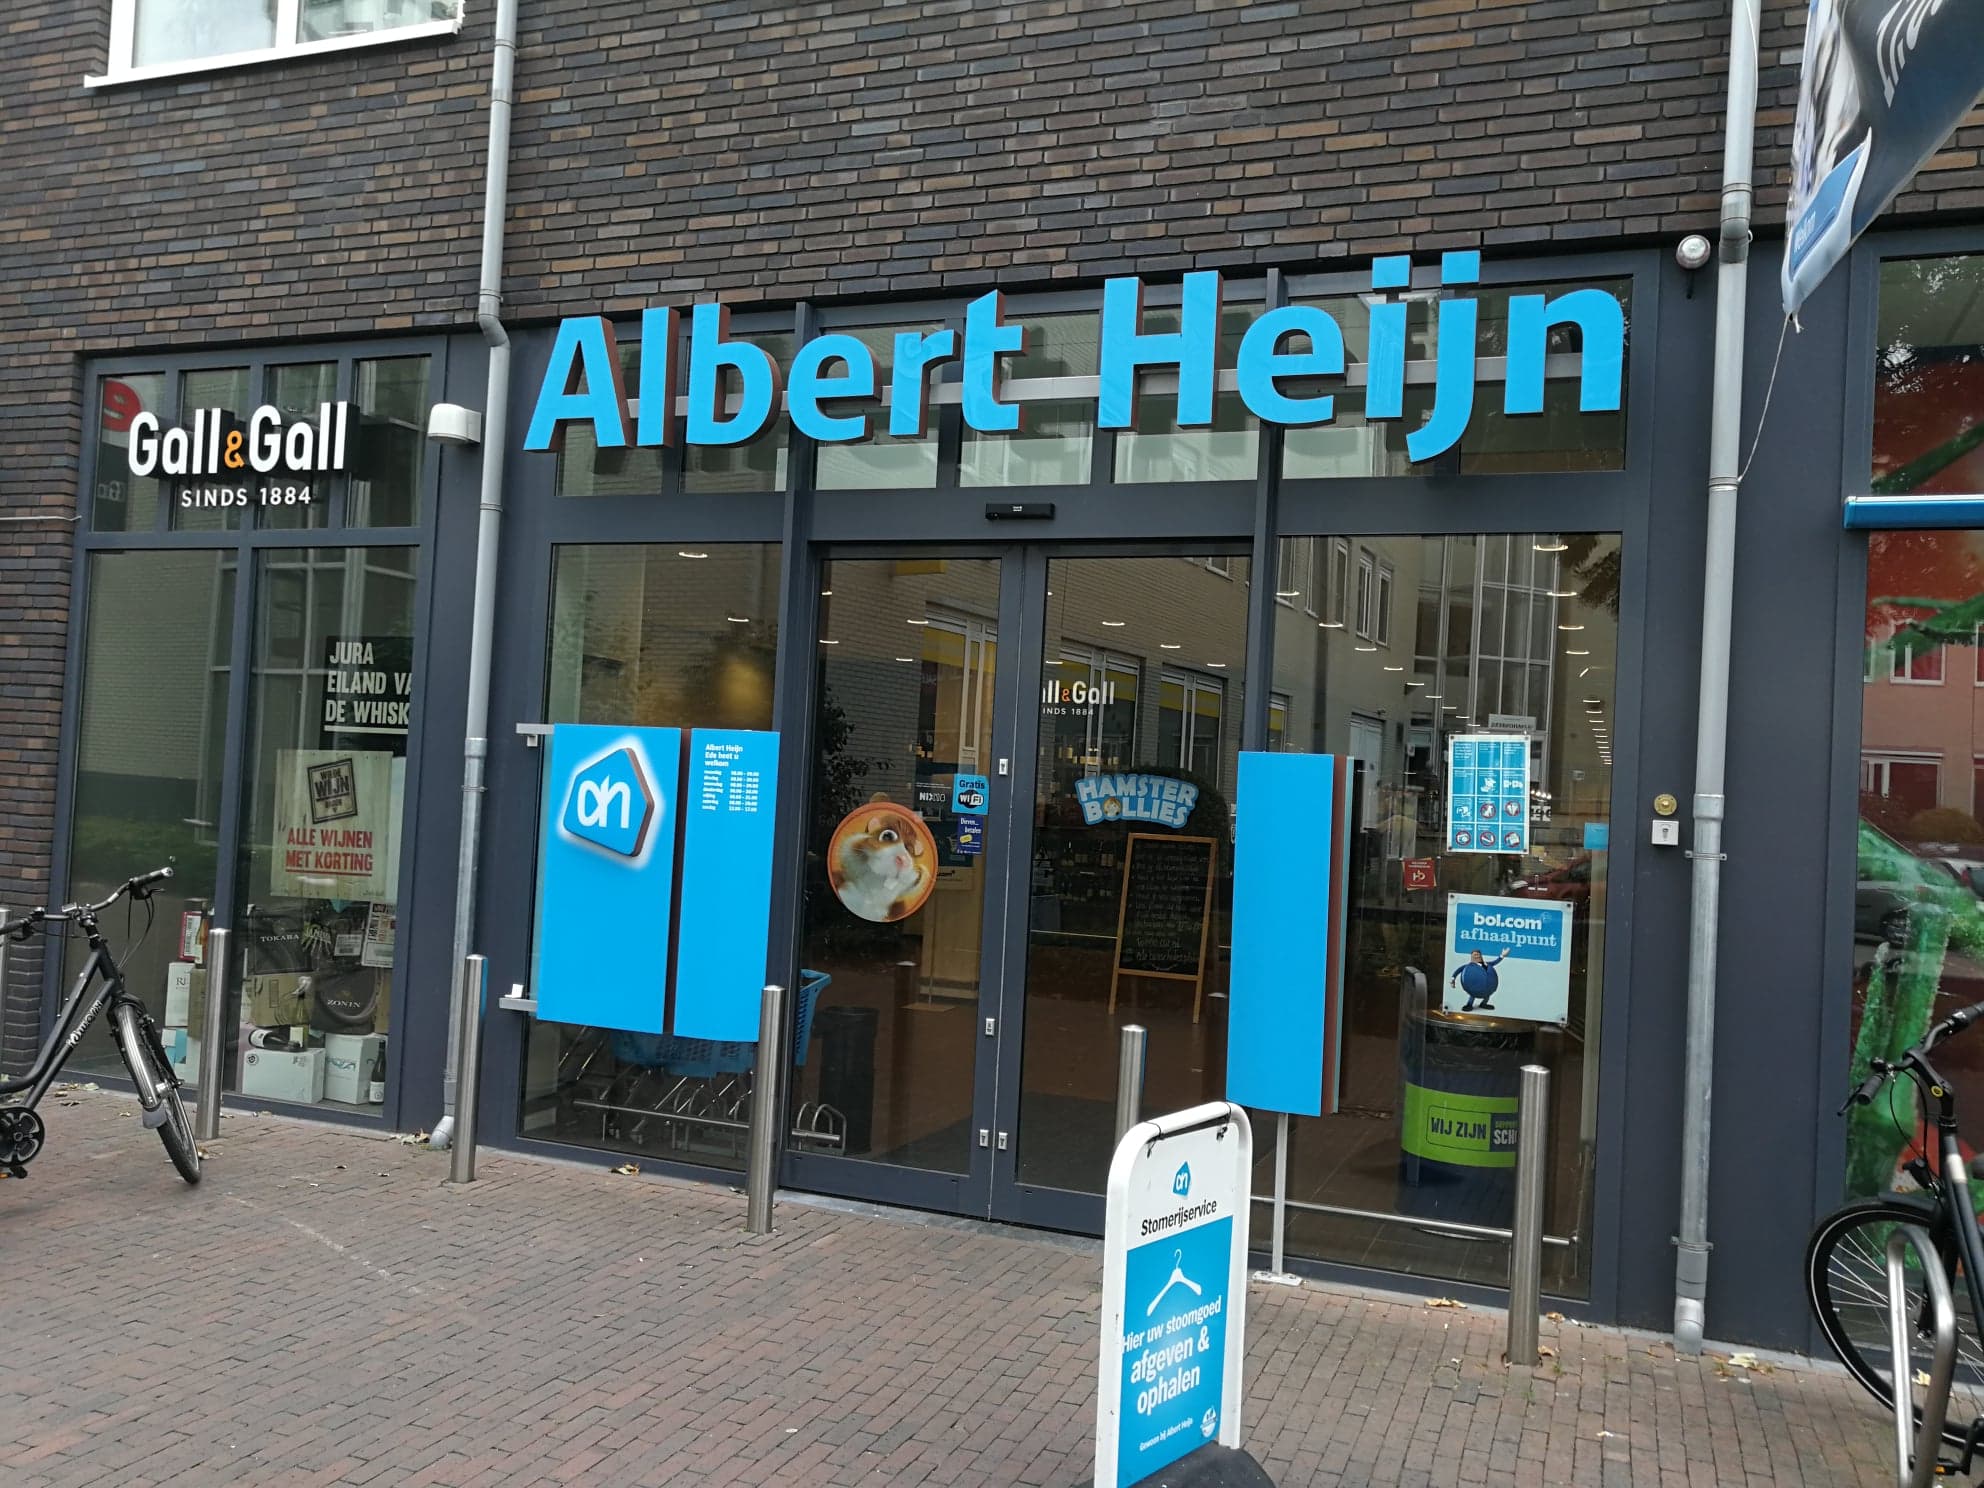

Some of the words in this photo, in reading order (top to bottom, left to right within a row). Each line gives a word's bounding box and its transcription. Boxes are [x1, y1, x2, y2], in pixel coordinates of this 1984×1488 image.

[522, 289, 1026, 452] Albert
[1097, 250, 1625, 462] Heijn
[181, 488, 248, 507] SINDS
[259, 486, 312, 505] 1884
[329, 641, 374, 665] JURA
[327, 670, 387, 695] EILAND
[394, 672, 413, 695] VA
[325, 699, 346, 722] DE
[353, 700, 411, 725] WHISK
[1042, 707, 1067, 715] INDS
[1071, 708, 1094, 716] 1884
[314, 776, 350, 797] WIJN
[959, 780, 985, 789] Gratis
[1077, 775, 1198, 807] HAMSTER
[287, 827, 316, 846] ALLE
[320, 829, 373, 849] WIJNEN
[285, 850, 312, 868] MET
[315, 851, 374, 871] KORTING
[1473, 912, 1543, 930] bol.com
[260, 934, 300, 943] TOKARA
[1460, 927, 1557, 948] afhaalpunt
[1431, 1117, 1453, 1135] WIJ
[1456, 1121, 1487, 1140] ZIJN
[1141, 1199, 1218, 1237] Stomerijservice
[1123, 1331, 1145, 1353] Hier
[1147, 1323, 1164, 1343] uw
[1166, 1295, 1222, 1334] stoomgoed
[1130, 1337, 1194, 1384] afgeven
[1197, 1325, 1210, 1353] &
[1137, 1366, 1201, 1416] ophalen
